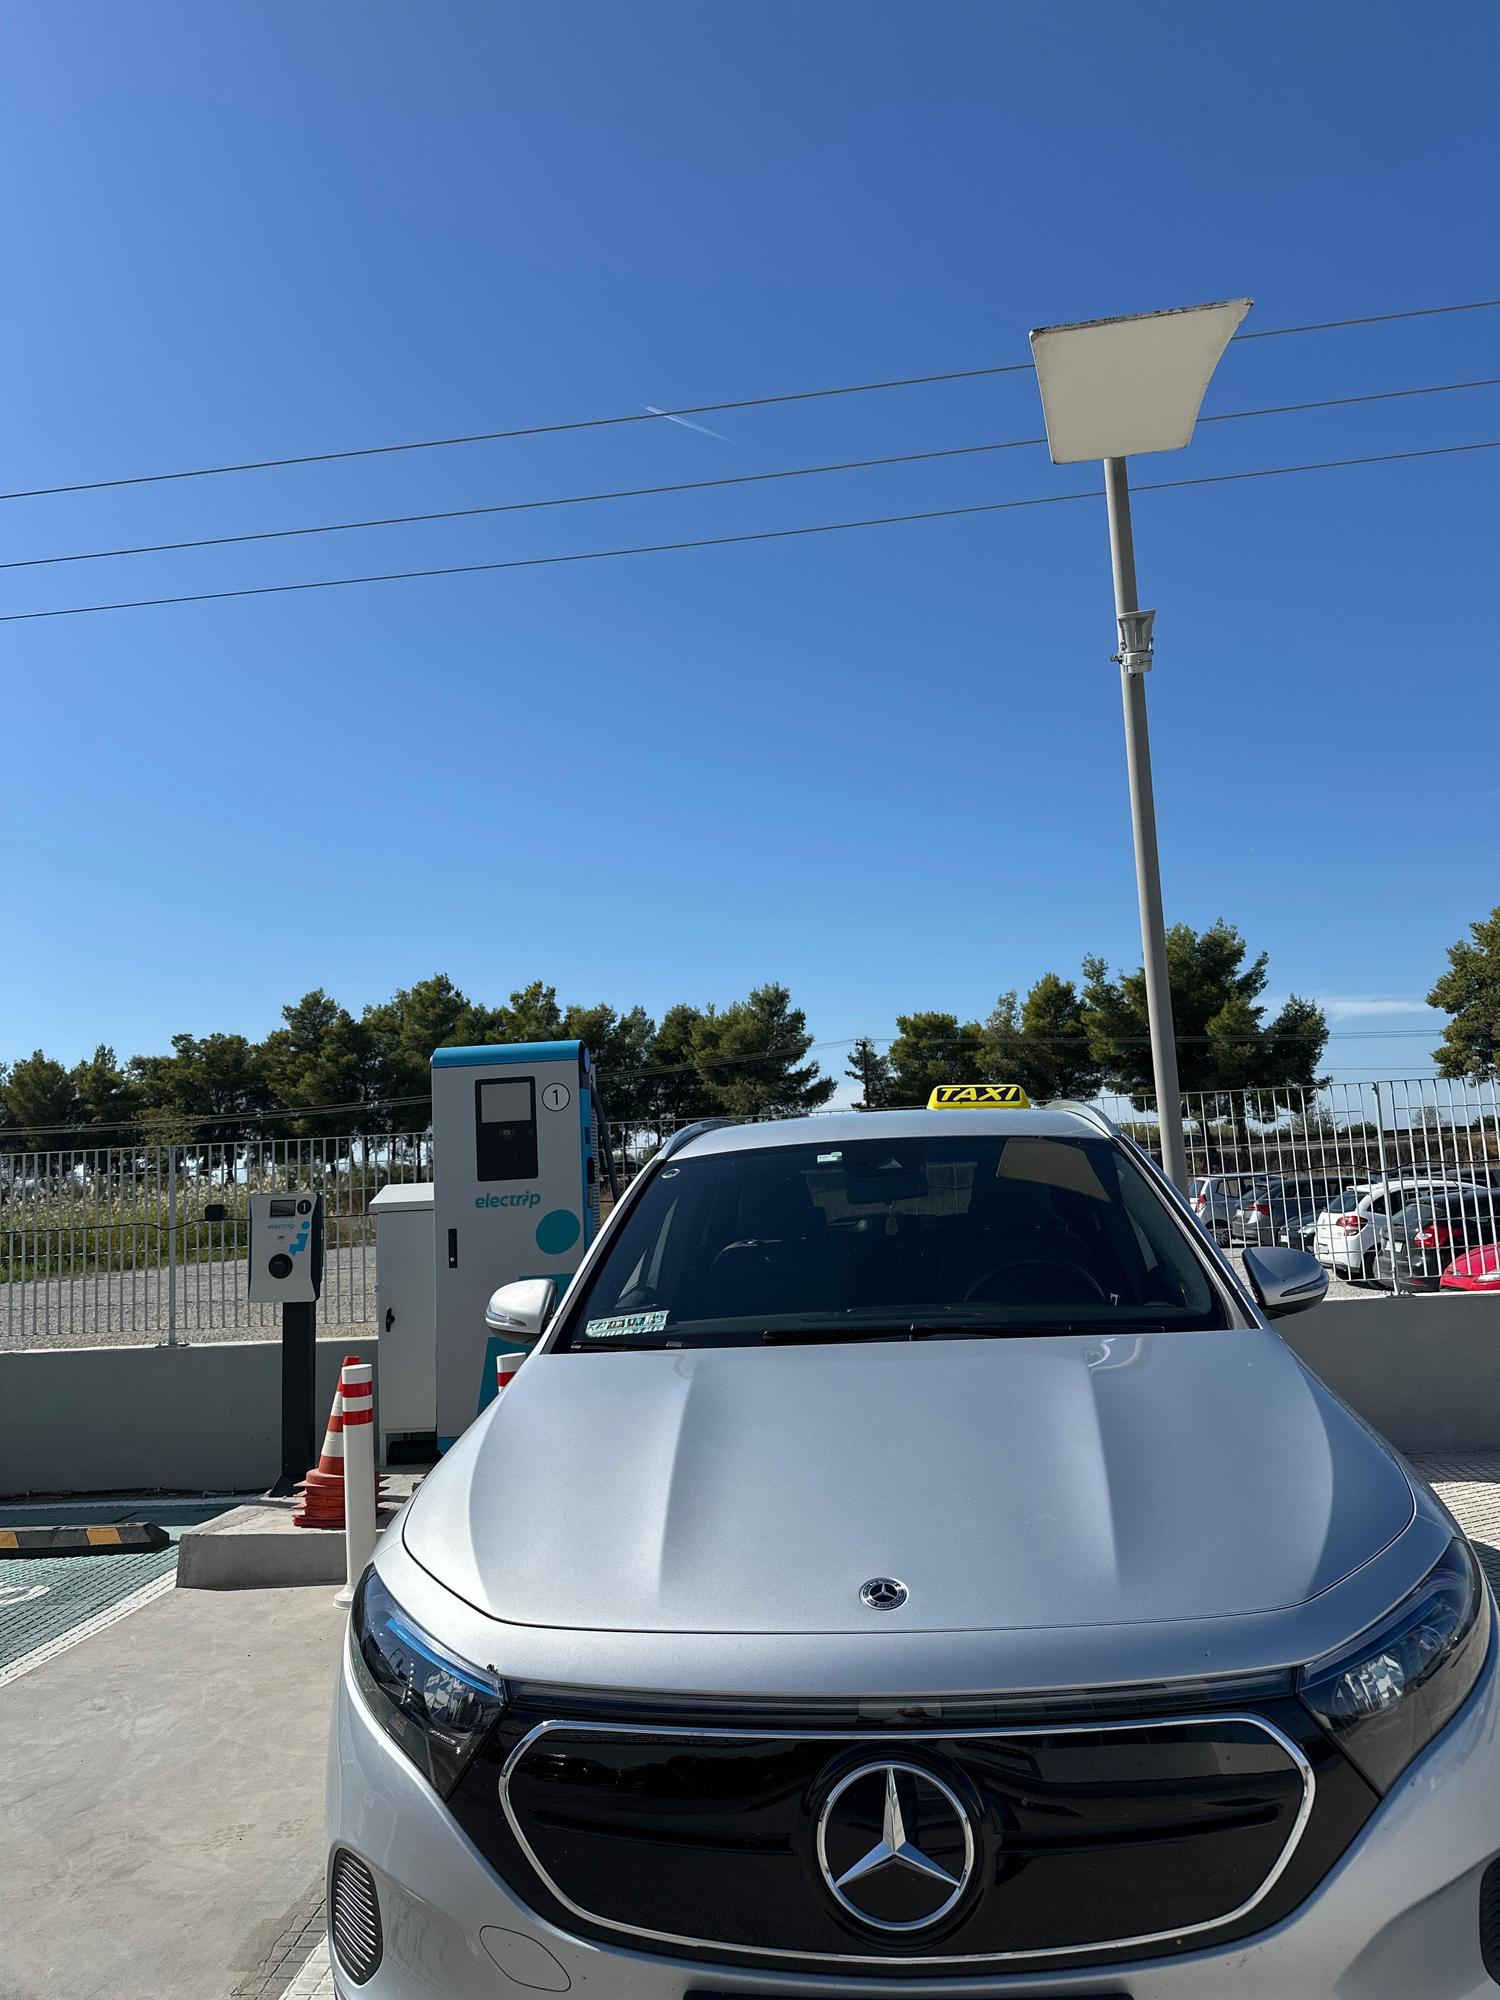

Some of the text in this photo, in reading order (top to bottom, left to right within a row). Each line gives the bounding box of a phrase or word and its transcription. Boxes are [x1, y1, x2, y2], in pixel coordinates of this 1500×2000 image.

[552, 1088, 560, 1106] 1
[941, 1087, 1018, 1101] TAXI
[475, 1190, 541, 1209] electrip
